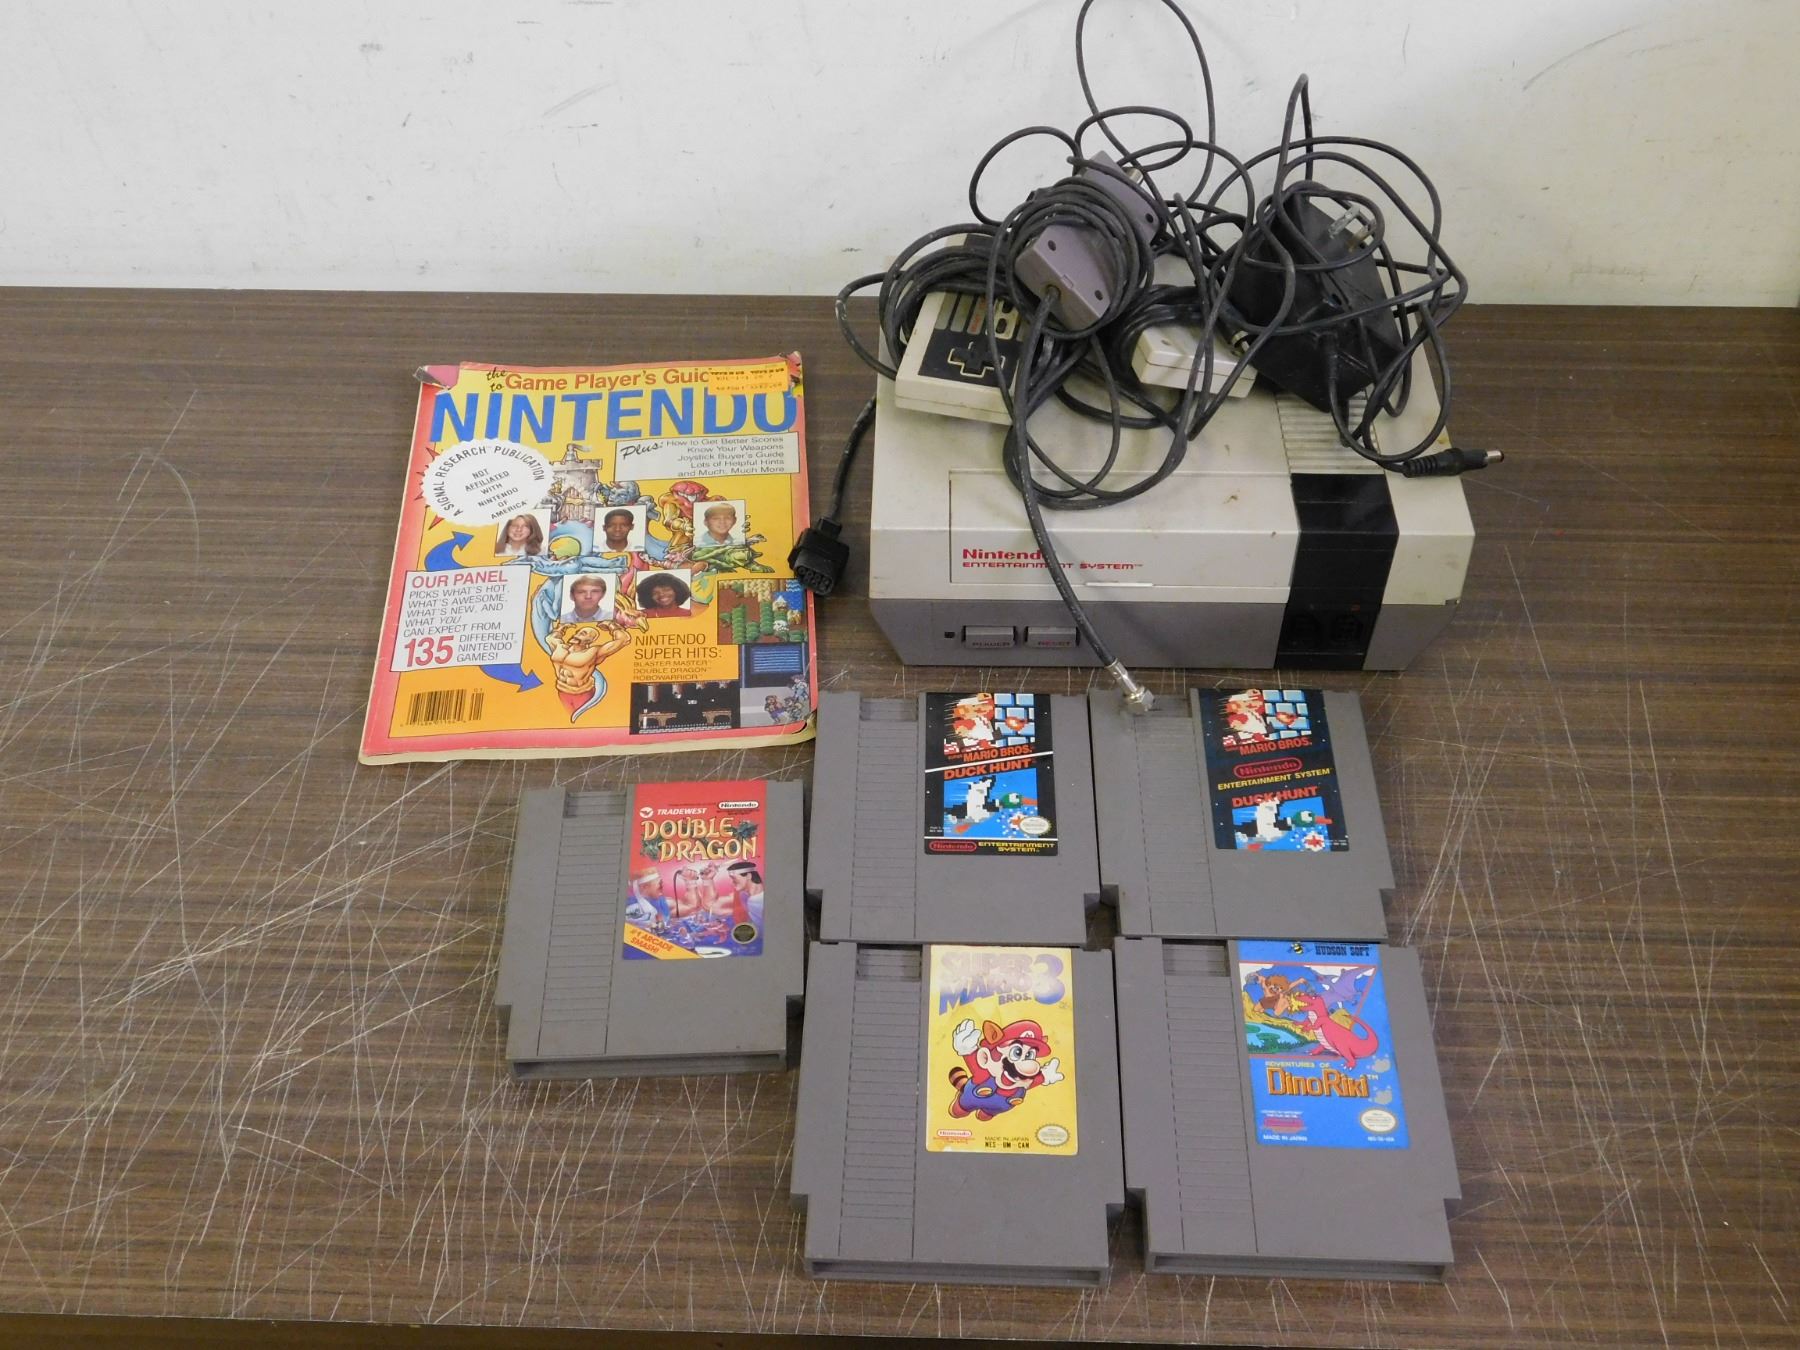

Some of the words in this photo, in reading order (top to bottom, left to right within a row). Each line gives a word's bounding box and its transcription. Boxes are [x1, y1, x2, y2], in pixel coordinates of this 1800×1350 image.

[486, 367, 506, 381] the
[505, 374, 568, 391] Game
[574, 370, 657, 391] Player's
[663, 368, 712, 385] Guid
[490, 382, 505, 392] to
[429, 387, 797, 444] NINTENDO
[620, 441, 664, 460] Plus:
[701, 438, 718, 446] Get
[721, 437, 748, 445] Better
[740, 444, 784, 452] Weapons
[435, 446, 487, 478] RESEARCH
[494, 446, 545, 481] PUBLICATION
[677, 454, 714, 462] Joystick
[718, 452, 753, 461] Buyer's
[724, 459, 758, 468] Helpful
[760, 458, 785, 466] Hints
[465, 470, 510, 492] AFFILIATED
[472, 468, 490, 480] NOT
[433, 481, 454, 511] SIGNAL
[480, 483, 503, 495] WITH
[477, 487, 519, 508] NINTENDO
[498, 500, 509, 508] OF
[491, 500, 528, 520] AMERICA
[962, 548, 1046, 560] Nintend
[412, 574, 449, 589] OUR
[453, 570, 509, 586] PANEL
[409, 590, 439, 600] PICKS
[442, 586, 482, 597] WHAT'S
[407, 608, 447, 618] WHAT'S
[481, 602, 504, 612] AND
[408, 598, 449, 608] WHAT'S
[403, 628, 425, 638] CAN
[428, 624, 468, 635] EXPECT
[470, 621, 502, 631] FROM
[405, 618, 435, 628] WHAT
[440, 616, 462, 625] YOU
[459, 632, 516, 643] DIFFERENT
[635, 633, 706, 646] NINTENDO
[404, 635, 455, 668] 135
[458, 642, 513, 652] NINTENDO
[634, 648, 682, 660] SUPER
[687, 646, 722, 658] HITS:
[456, 652, 499, 663] GAMES!
[964, 749, 998, 762] MARIO
[1000, 744, 1032, 757] BROS.
[1240, 741, 1277, 756] MARIO
[1278, 736, 1312, 750] BROS.
[944, 764, 987, 780] DUCK
[990, 758, 1032, 773] HUNT
[1240, 762, 1298, 776] Nintendo
[1218, 774, 1292, 790] ENTERTAINMENT
[1295, 768, 1330, 779] SYSTEM
[1277, 786, 1318, 800] HUNT
[657, 808, 708, 816] TRADEWEST
[641, 816, 734, 841] DOUBLE
[658, 836, 757, 862] DRAGON
[641, 934, 674, 952] ARCADE
[1315, 946, 1347, 956] HUDSON
[1350, 946, 1370, 956] SOFT
[1033, 954, 1066, 1005] 3
[998, 992, 1032, 1006] BROS.
[1266, 1068, 1370, 1098] DinoRiki
